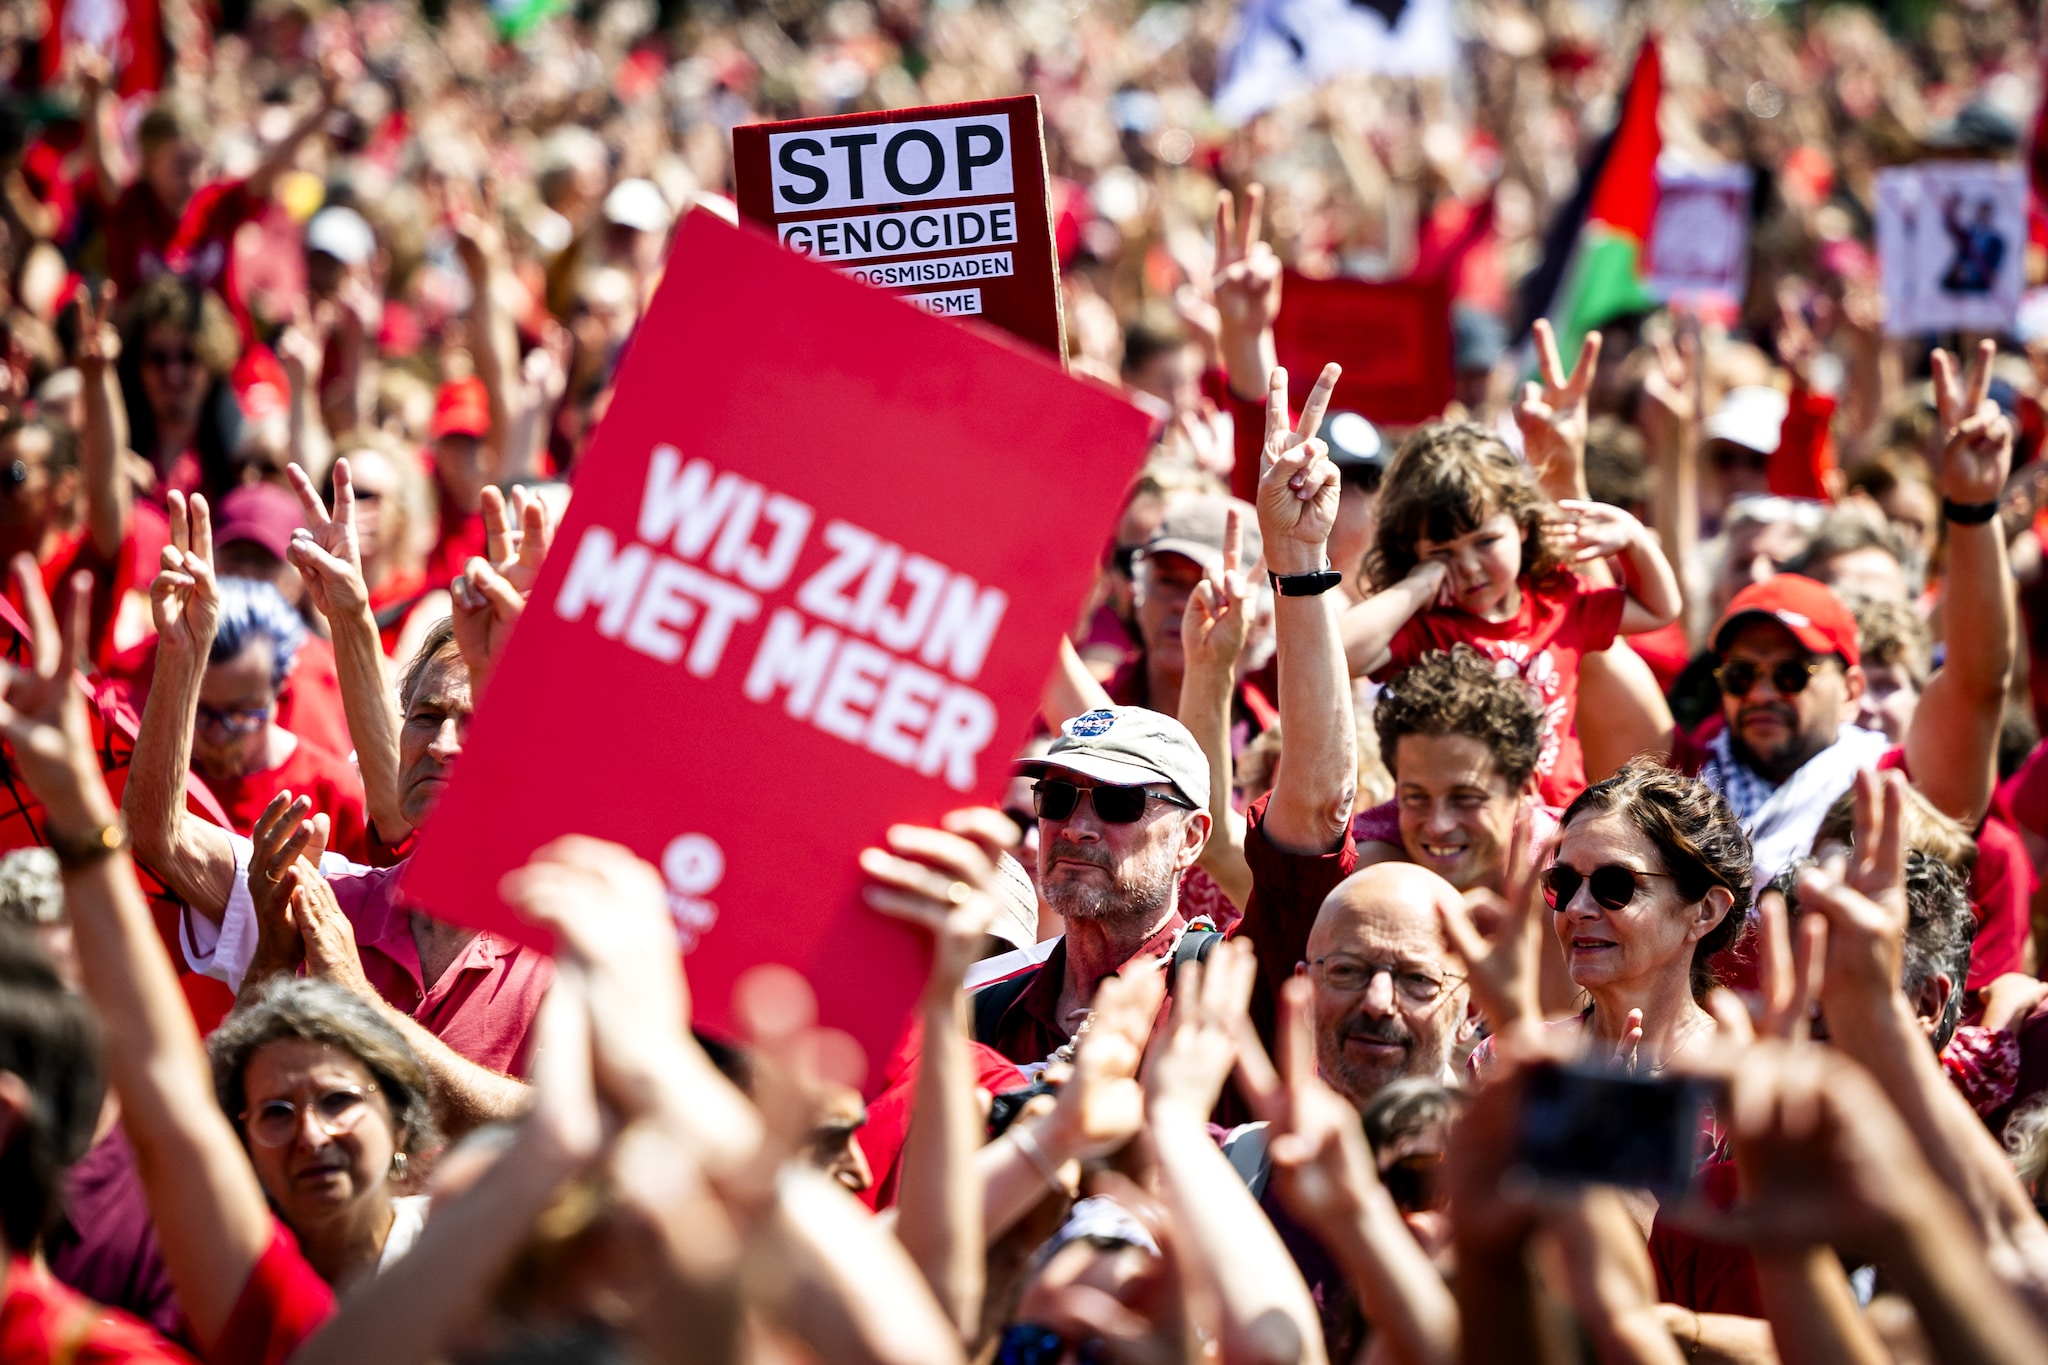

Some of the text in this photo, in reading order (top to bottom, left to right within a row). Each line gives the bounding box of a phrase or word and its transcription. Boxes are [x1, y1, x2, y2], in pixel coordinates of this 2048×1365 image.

[778, 124, 1004, 205] STOP
[784, 209, 1013, 257] GENOCIDE
[850, 257, 1009, 285] OGSMISDADEN
[914, 294, 977, 314] ISME
[638, 442, 1008, 682] WIJ ZIJN
[555, 525, 997, 793] MET MEER
